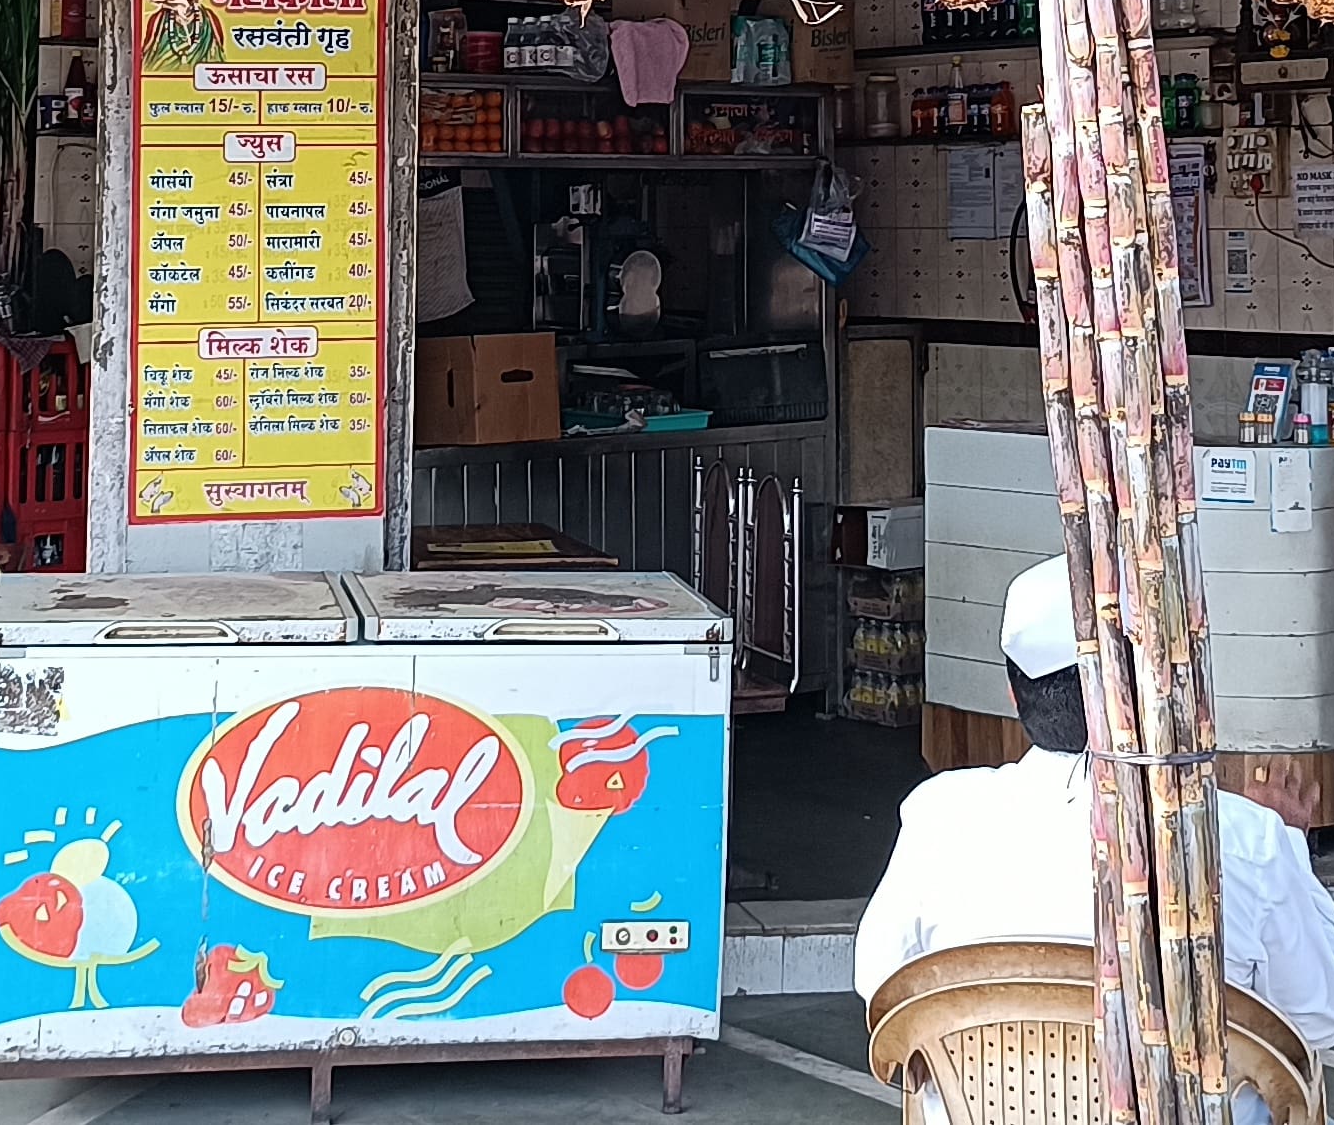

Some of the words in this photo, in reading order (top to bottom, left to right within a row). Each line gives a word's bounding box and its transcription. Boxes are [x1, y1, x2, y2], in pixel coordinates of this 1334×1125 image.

[232, 20, 311, 47] रसवंती
[317, 28, 351, 54] गृह
[811, 27, 851, 48] Bisleri
[205, 67, 279, 85] ऊसाचा
[284, 67, 315, 85] रस
[149, 102, 171, 118] फुल
[174, 103, 205, 113] ग्लास
[209, 98, 239, 113] 15/-
[267, 102, 289, 114] हाफ
[293, 103, 322, 113] ग्लास
[327, 98, 356, 113] 10/-
[236, 134, 284, 159] ज्युस
[149, 169, 193, 189] मोसंबी
[229, 172, 253, 185] 45/-
[266, 169, 293, 188] संत्रा
[349, 171, 373, 185] 45/-
[1297, 172, 1308, 180] NO
[1309, 172, 1332, 180] MASK
[149, 201, 178, 219] गंगा
[181, 206, 220, 224] जमुना
[229, 203, 253, 216] 45/-
[266, 206, 325, 219] पायनापल
[349, 202, 373, 216] 45/-
[229, 234, 252, 248] 50/-
[266, 230, 322, 249] मारामारी
[349, 233, 373, 246] 45/-
[149, 262, 201, 282] कॉकटेल
[228, 266, 252, 280] 45/-
[265, 262, 316, 279] कलींगड
[349, 263, 372, 277] 40/-
[228, 296, 251, 310] 55/-
[266, 292, 307, 311] सिकंदर
[310, 296, 345, 310] सरबत
[349, 294, 372, 308] 20/-
[206, 331, 263, 356] मिल्क
[270, 329, 311, 355] शेक
[144, 365, 169, 386] चिकू
[172, 364, 193, 381] शेक
[215, 370, 237, 382] 45/-
[249, 363, 268, 379] रोज
[272, 363, 300, 378] मिल्क
[304, 362, 325, 378] शेक
[349, 365, 371, 378] 35/-
[170, 391, 191, 407] शेक
[215, 395, 237, 408] 60/-
[287, 390, 314, 405] मिल्क
[318, 389, 340, 404] शेक
[350, 392, 371, 404] 60/-
[143, 419, 188, 435] सिताफल
[192, 418, 214, 434] शेक
[215, 422, 237, 435] 60/-
[288, 416, 317, 431] मिल्क
[319, 414, 341, 431] शेक
[349, 419, 371, 431] 35/-
[174, 444, 196, 461] शेक
[215, 449, 237, 461] 60/-
[205, 480, 311, 506] सुस्वागतम्
[202, 701, 499, 865] Vadilal
[248, 855, 305, 899] ICE
[328, 859, 448, 905] CREAM
